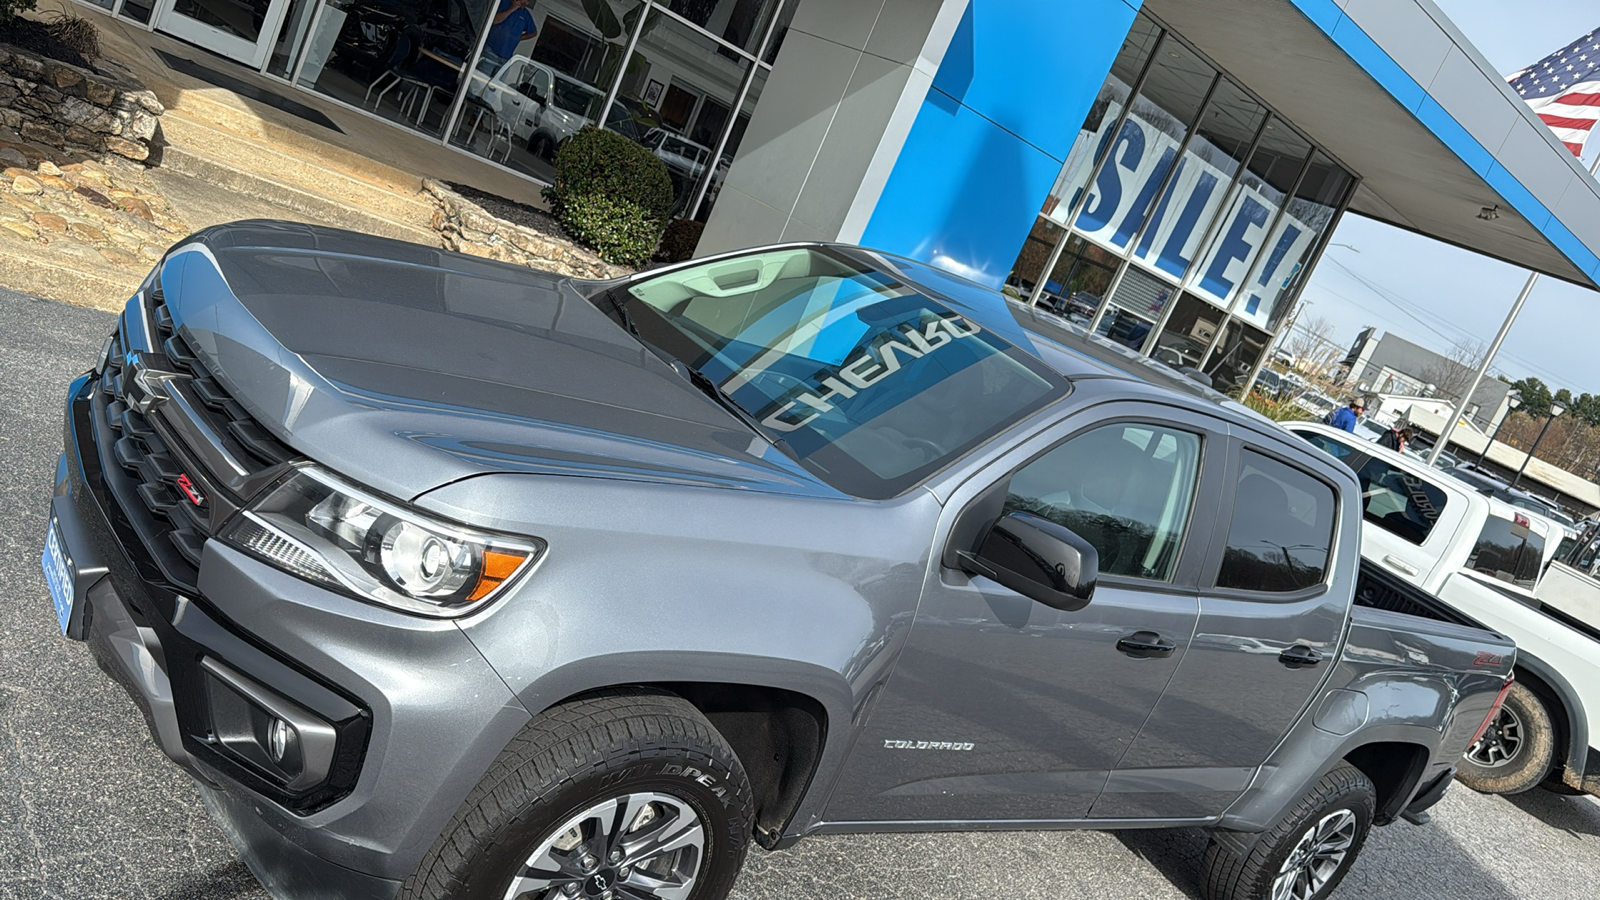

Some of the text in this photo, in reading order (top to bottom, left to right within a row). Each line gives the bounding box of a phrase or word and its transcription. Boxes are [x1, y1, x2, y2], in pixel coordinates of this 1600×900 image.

[1067, 117, 1303, 317] SALE!
[48, 528, 75, 606] CERTIFIED
[883, 739, 976, 751] COLORADO
[599, 762, 736, 810] WILDPEAK
